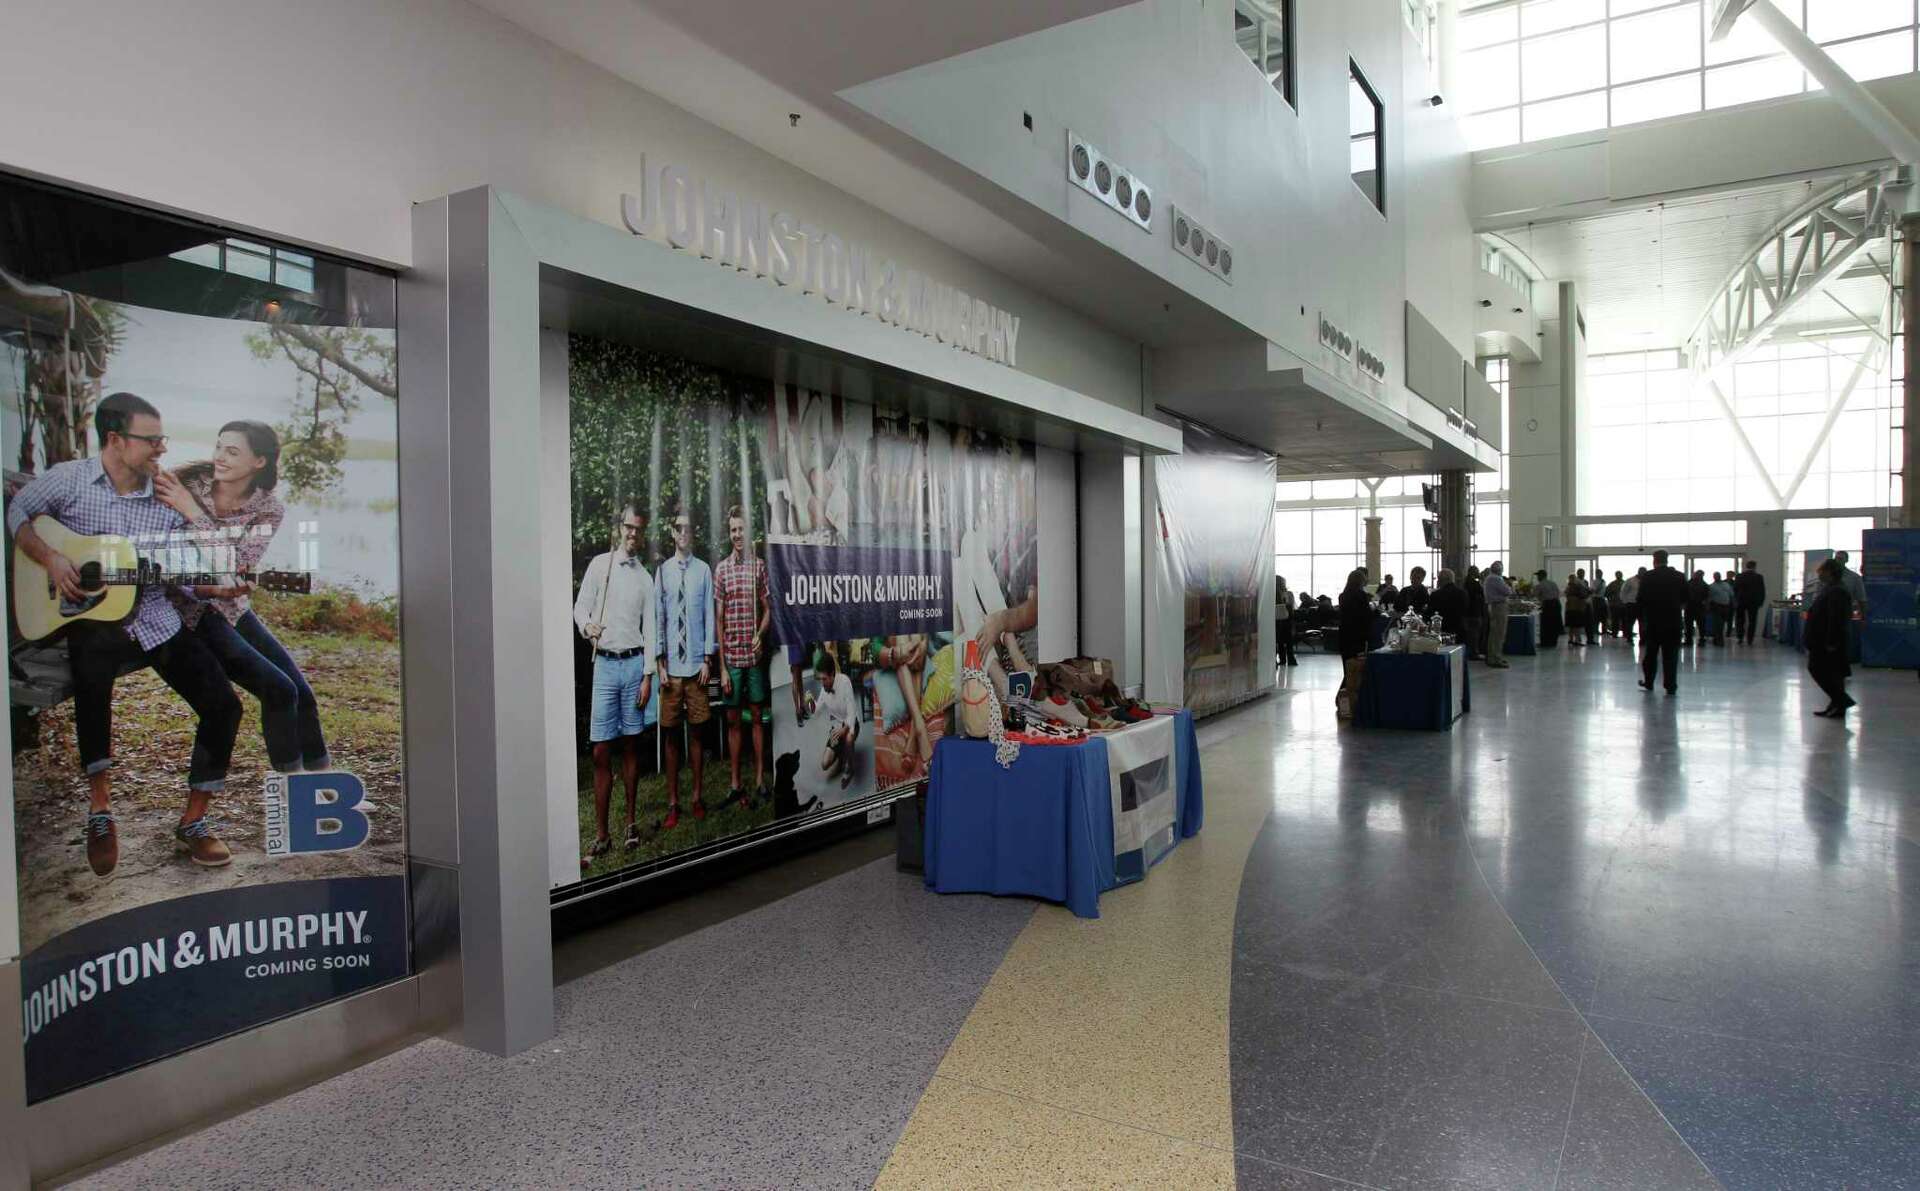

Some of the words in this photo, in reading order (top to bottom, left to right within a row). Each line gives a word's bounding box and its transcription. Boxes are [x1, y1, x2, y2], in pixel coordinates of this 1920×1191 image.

[620, 152, 872, 313] JOHNSTON
[902, 269, 1020, 367] MURPHY
[785, 574, 872, 605] JOHNSTON
[874, 575, 886, 602] &
[887, 575, 942, 600] MURPHY
[900, 609, 925, 620] COMING
[926, 608, 943, 618] SOON
[266, 776, 286, 855] terminal
[288, 773, 369, 853] B
[23, 939, 165, 1043] JOHNSTON
[173, 930, 205, 968] &
[245, 959, 316, 978] COMING
[322, 954, 370, 970] SOON
